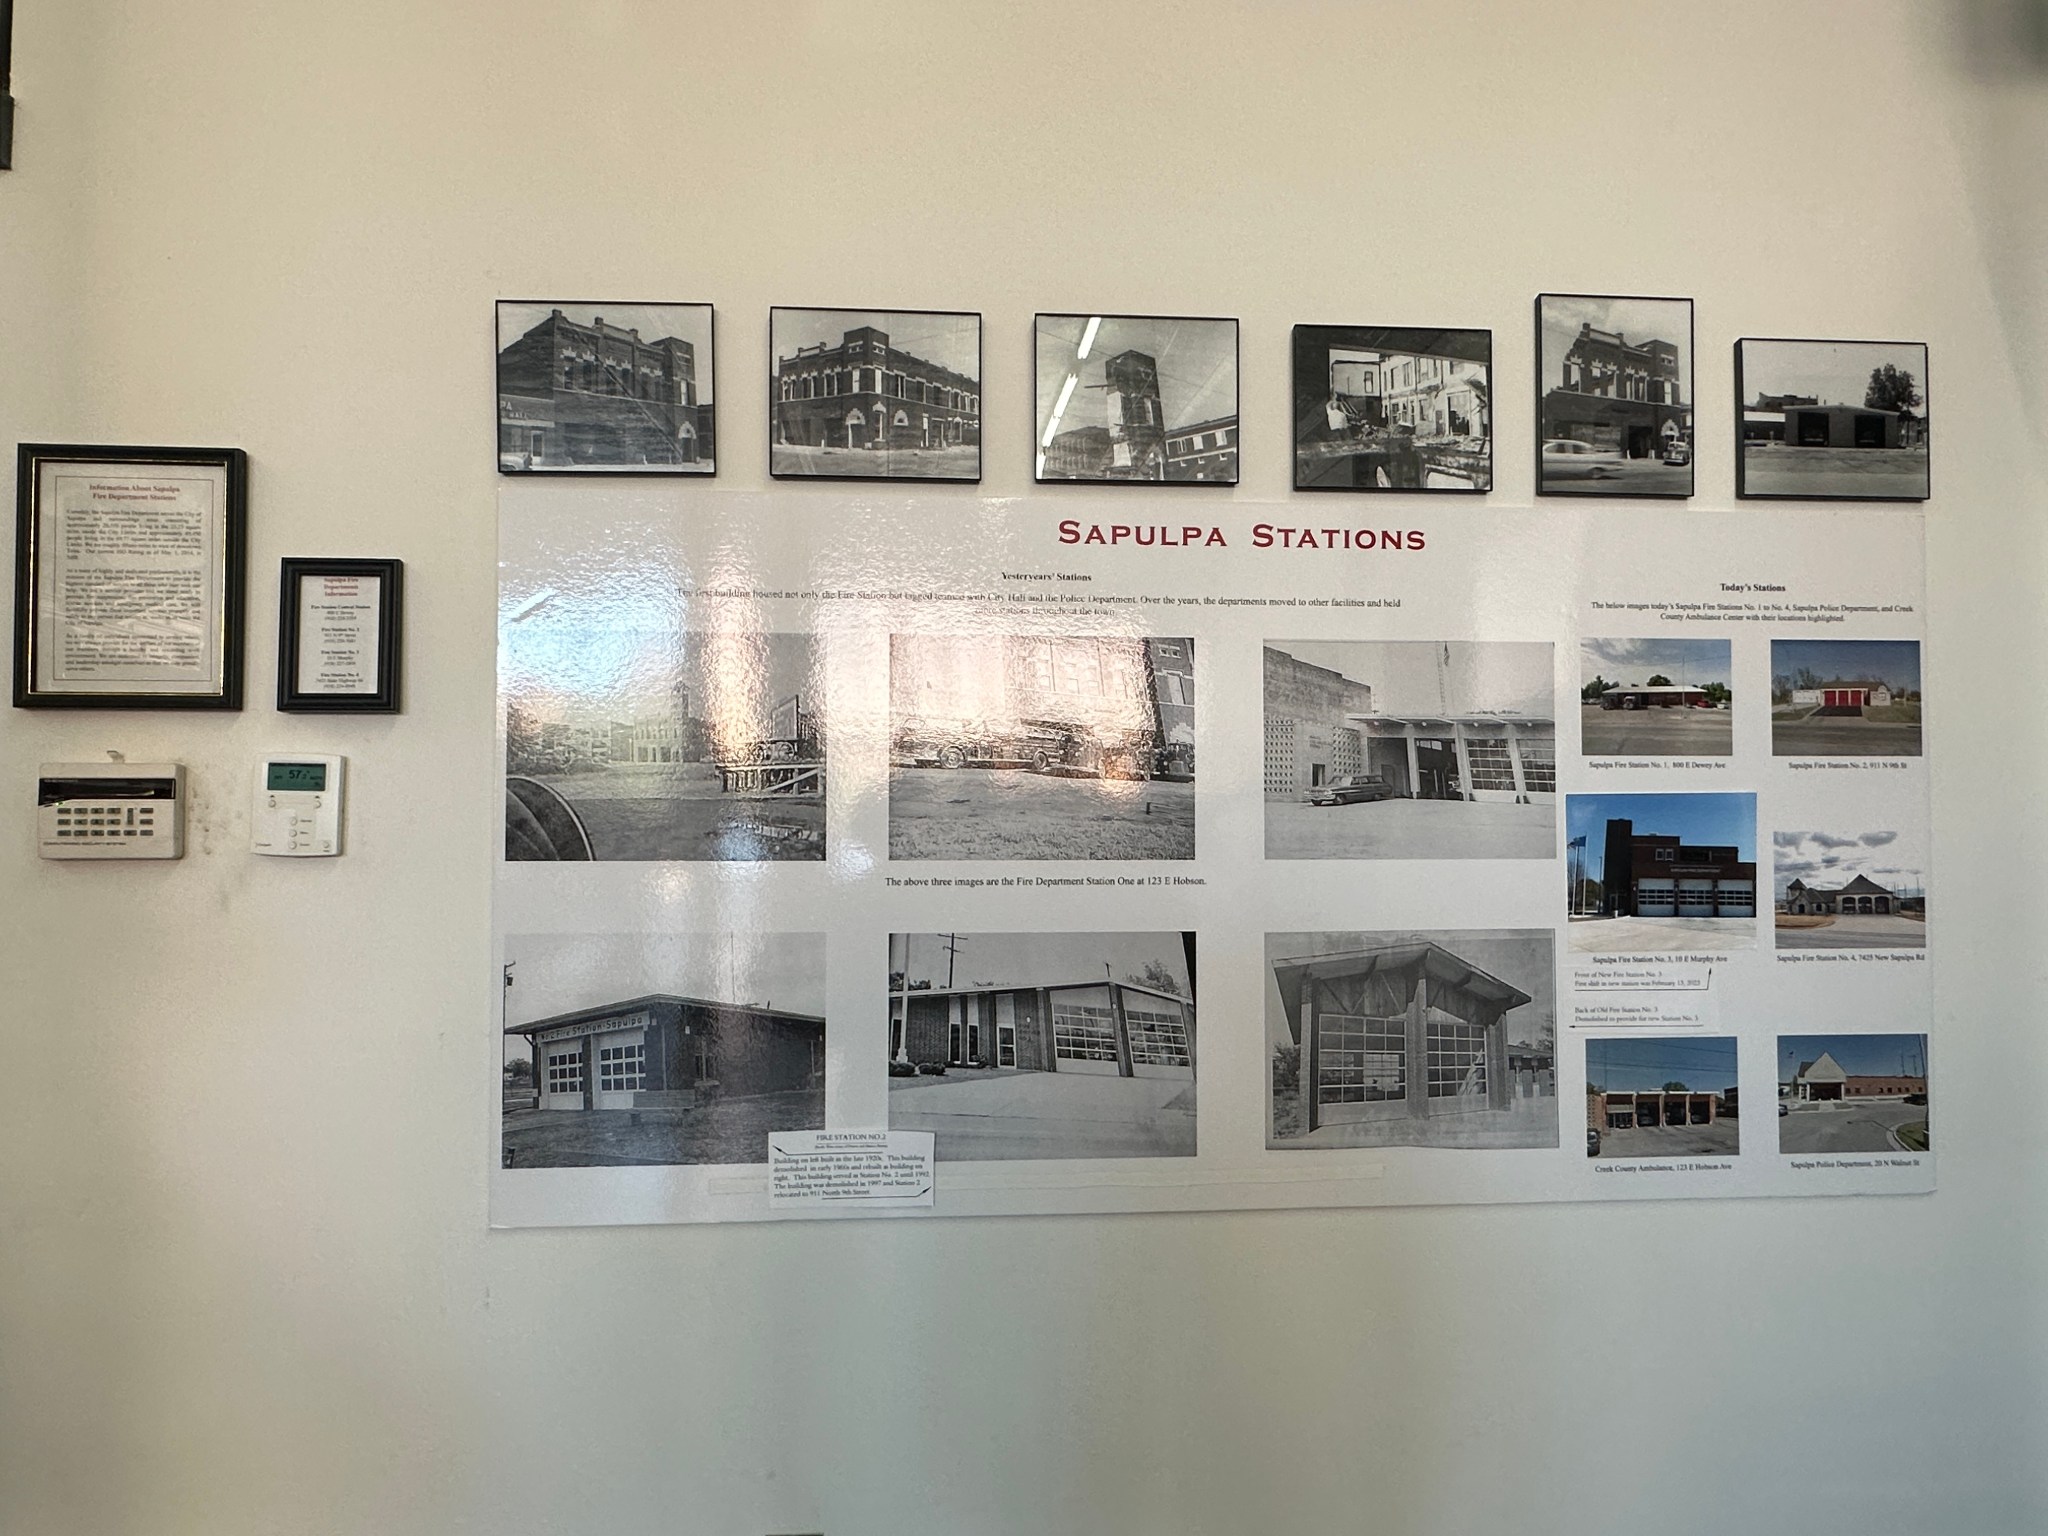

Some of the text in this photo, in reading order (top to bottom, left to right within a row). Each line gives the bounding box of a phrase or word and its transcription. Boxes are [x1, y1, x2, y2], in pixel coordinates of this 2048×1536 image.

[1058, 519, 1426, 551] SAPULPA STATIONS
[1002, 572, 1092, 582] Yesteryears' Stations
[1720, 583, 1785, 593] Today's Stations
[753, 590, 783, 599] housed
[800, 592, 818, 602] only
[1060, 594, 1084, 603] Police
[1141, 595, 1161, 604] Over
[1163, 596, 1176, 605] the
[1178, 598, 1202, 607] years,
[1204, 597, 1217, 605] the
[1219, 597, 1267, 608] departments
[1269, 598, 1297, 606] moved
[1309, 598, 1329, 607] other
[1331, 598, 1365, 607] facilities
[1367, 599, 1381, 607] and
[1384, 599, 1401, 608] held
[1627, 603, 1649, 611] images
[1651, 603, 1674, 611] today's
[1675, 603, 1701, 612] Sapulpa
[1793, 604, 1818, 613] Sapulpa
[1819, 604, 1840, 612] Police
[1894, 605, 1914, 613] Creek
[1660, 613, 1684, 622] County
[1685, 613, 1721, 621] Ambulance
[885, 877, 1207, 888] The above three images are the Fire Department Station One at 123 E Hobson.
[556, 1028, 571, 1038] Fire
[834, 1133, 867, 1141] STATION
